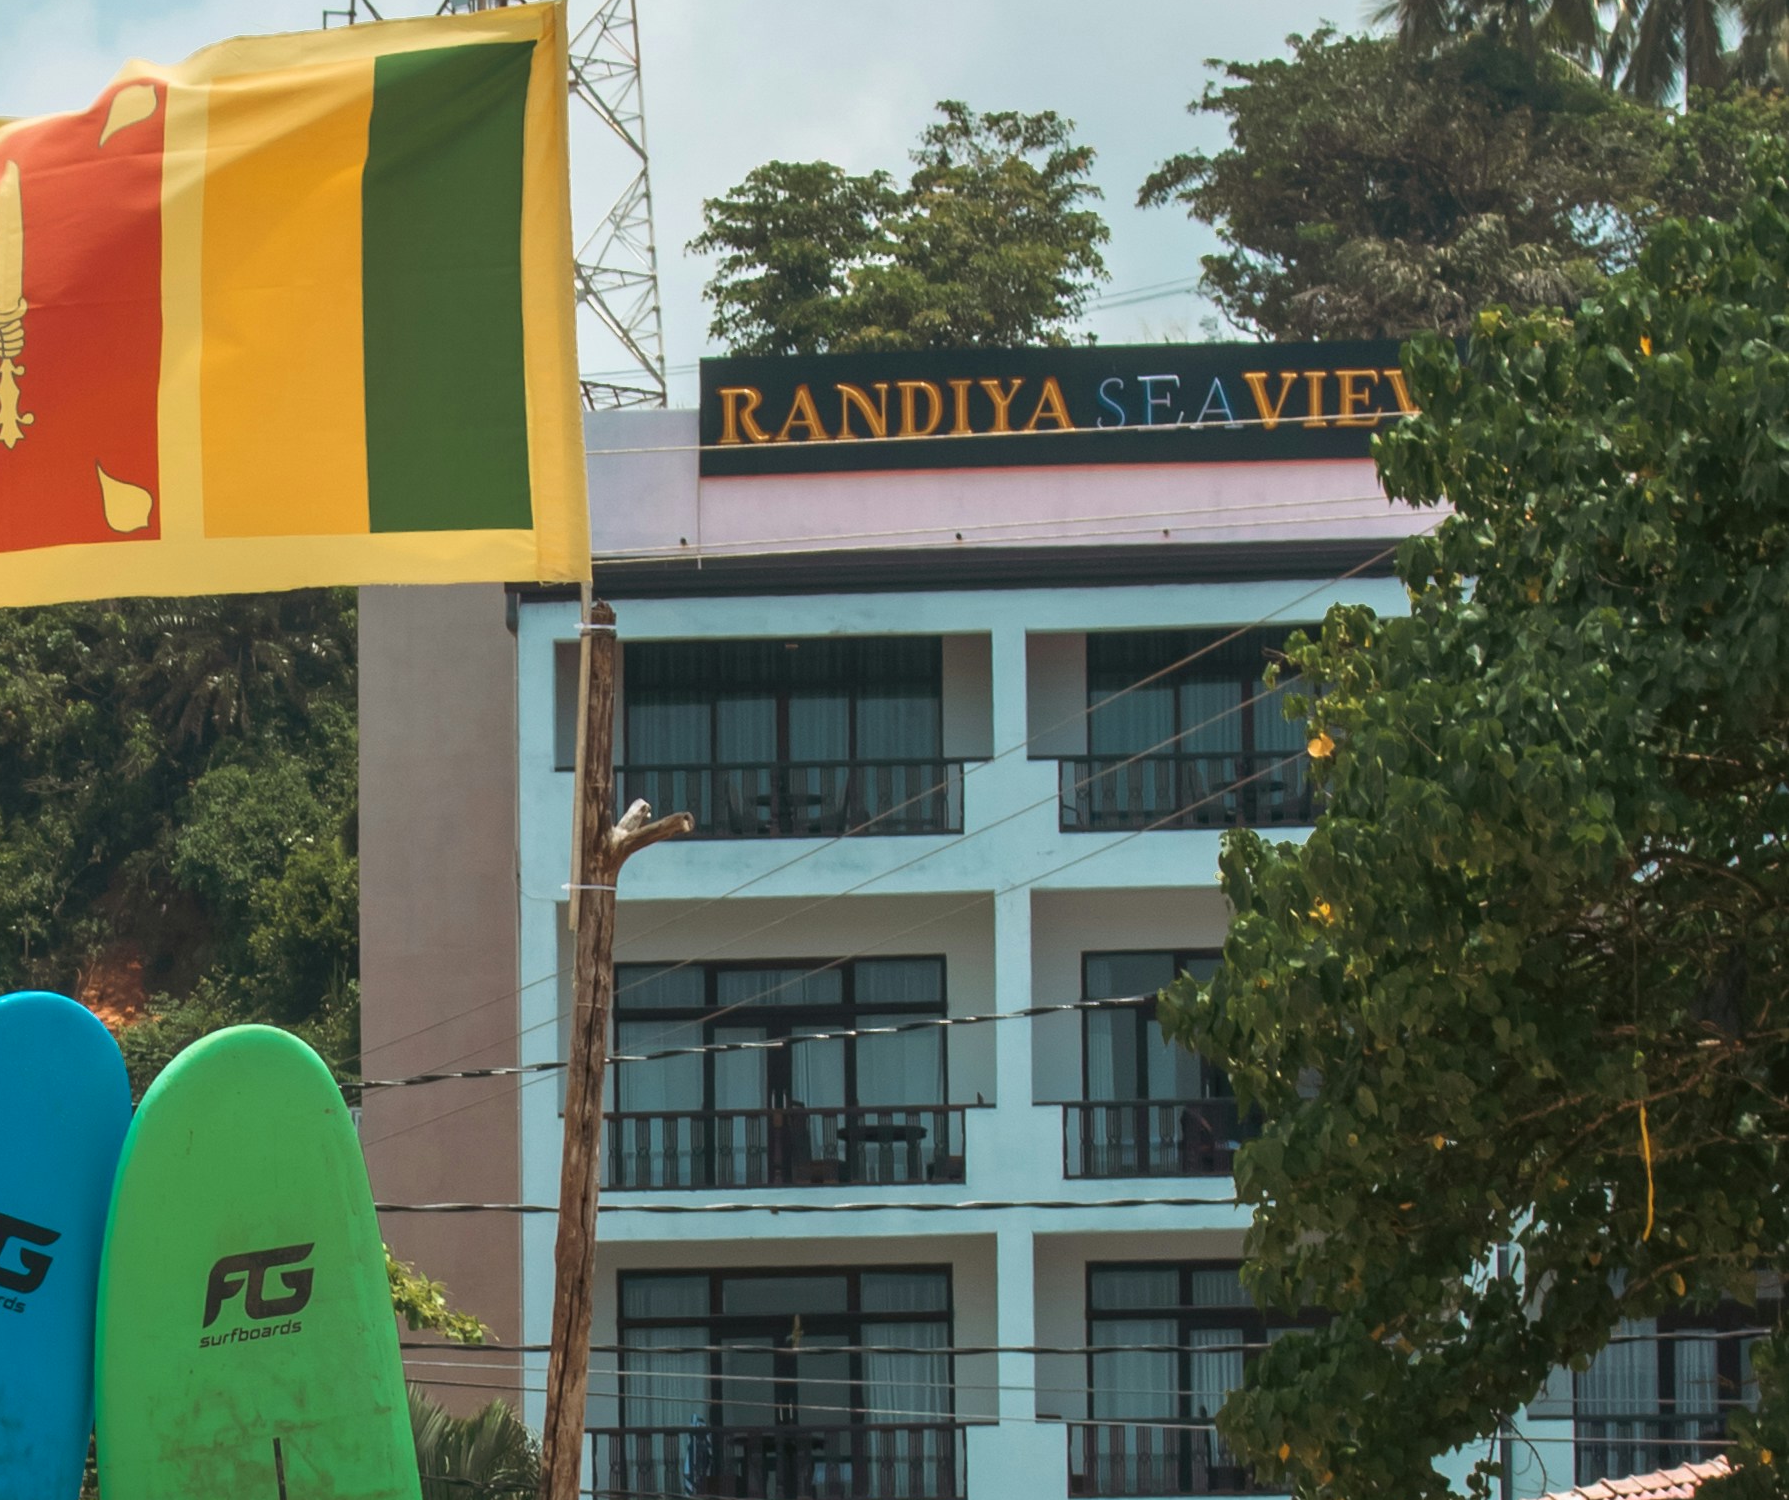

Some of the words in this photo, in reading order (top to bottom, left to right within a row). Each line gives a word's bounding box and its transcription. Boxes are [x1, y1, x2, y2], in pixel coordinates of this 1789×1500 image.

[718, 376, 1077, 445] RANDIYA
[202, 1241, 316, 1329] FG
[199, 1319, 303, 1349] surfboards
